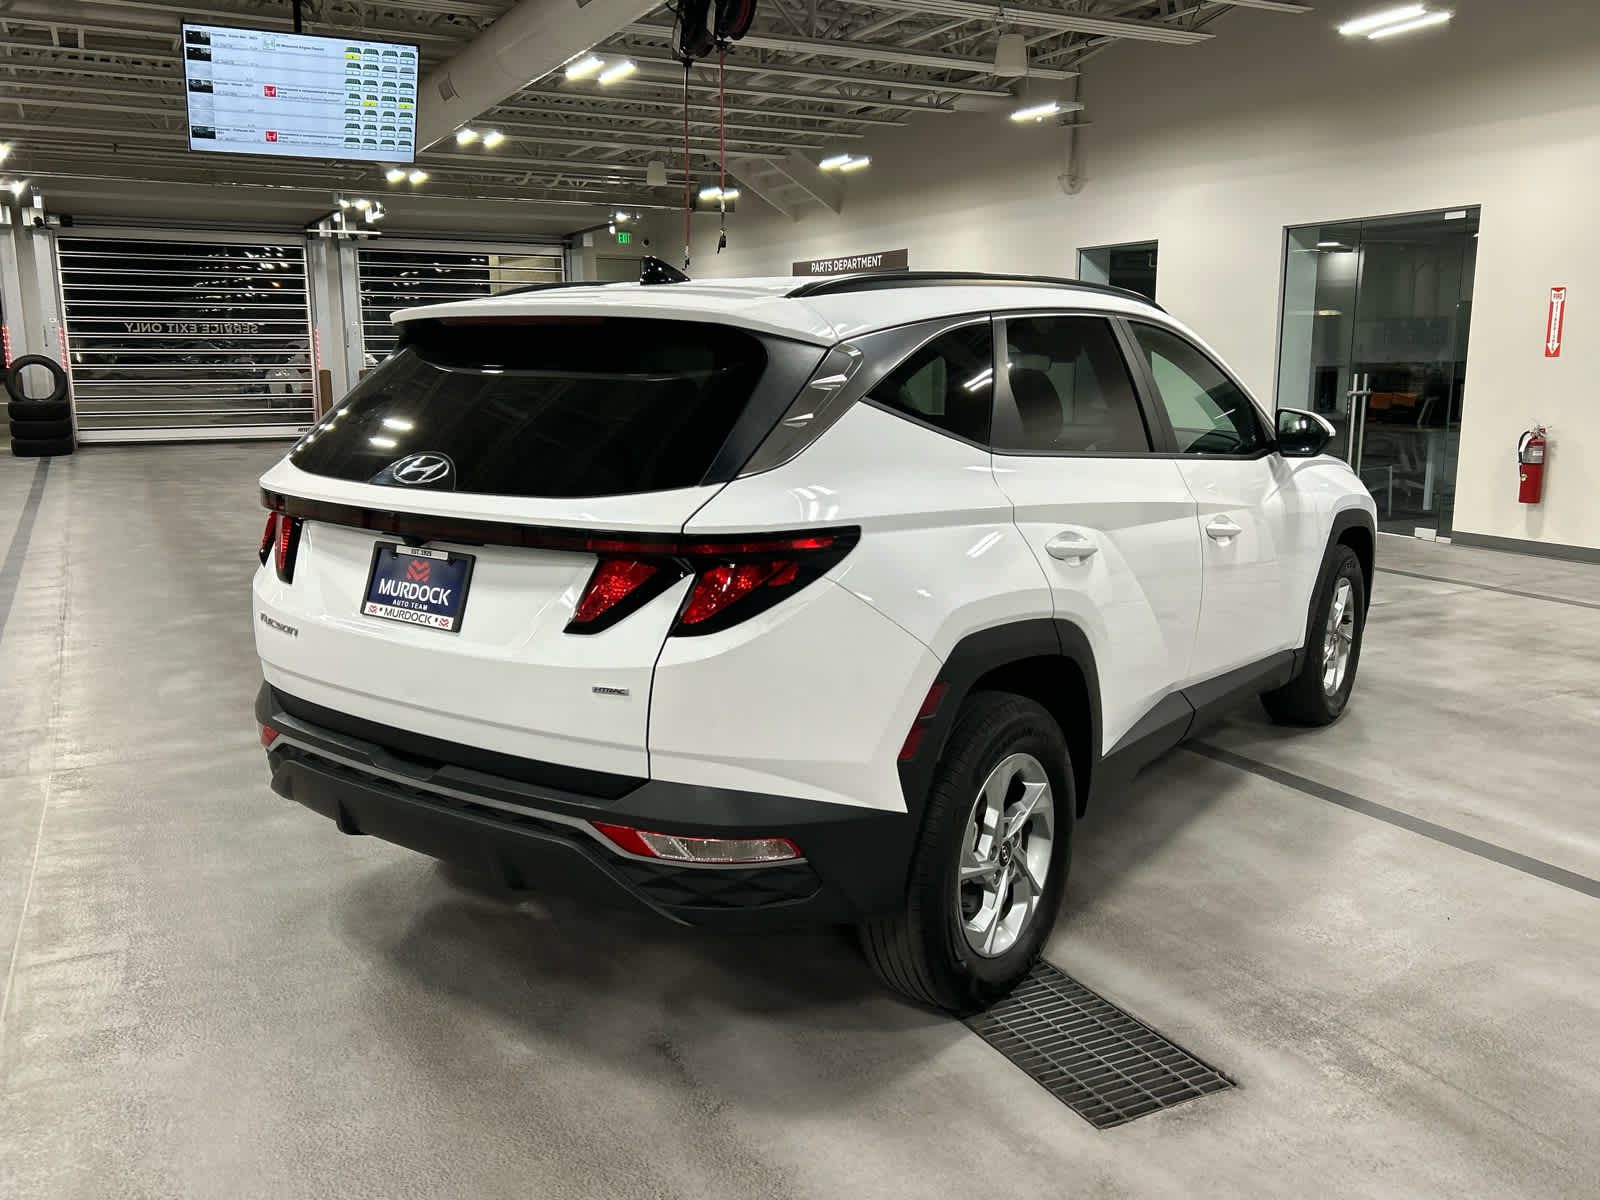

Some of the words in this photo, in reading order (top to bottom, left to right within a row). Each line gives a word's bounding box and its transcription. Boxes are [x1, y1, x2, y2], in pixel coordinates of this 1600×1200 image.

[811, 261, 832, 272] PARTS
[833, 255, 883, 270] DEPARTMENT
[378, 578, 451, 606] MURDOCK
[392, 599, 409, 608] AUTO
[411, 601, 428, 611] TEAM
[384, 607, 432, 624] MURDOCK
